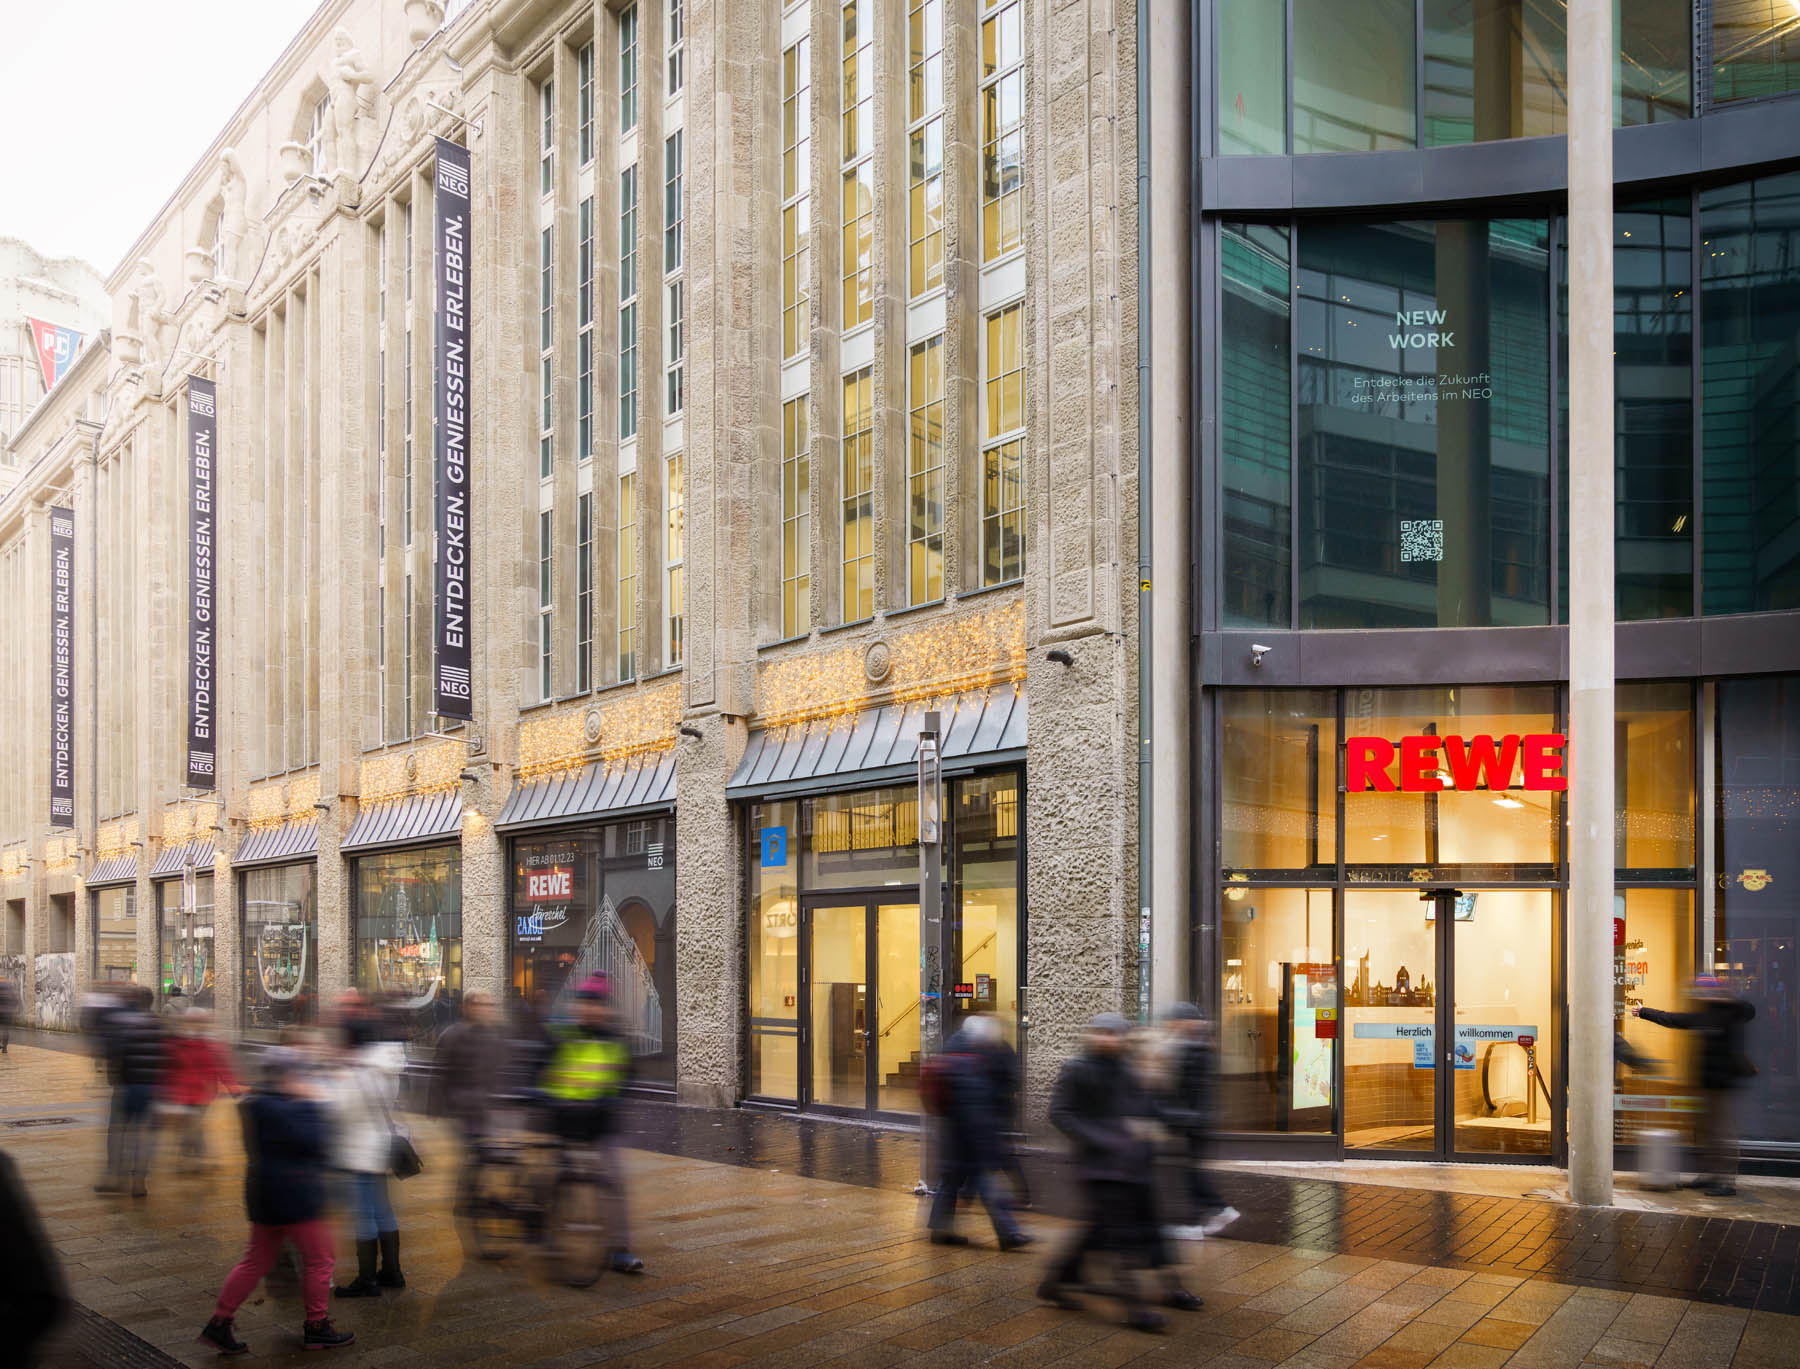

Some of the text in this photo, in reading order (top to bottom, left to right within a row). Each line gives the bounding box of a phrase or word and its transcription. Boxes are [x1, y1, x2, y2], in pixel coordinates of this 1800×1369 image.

[439, 173, 468, 194] NEO
[1396, 310, 1447, 326] NEW
[1388, 332, 1455, 349] WORK
[1354, 373, 1490, 388] Entdecke die Zukunft
[1351, 388, 1493, 403] des Arbeitens im NEO
[191, 402, 214, 414] NEO
[446, 215, 464, 648] ENTDECKEN. GENIESSEN. ERLEBEN.
[53, 525, 73, 536] NEO
[195, 429, 210, 739] ENTDECKEN. GENIESSEN. ERLEBEN.
[56, 547, 69, 788] ENTDECKEN. GENIESSEN. ERLEBEN.
[441, 680, 469, 695] NEO
[190, 762, 214, 772] NEO
[1347, 734, 1567, 792] REWE
[53, 806, 72, 814] NEO
[526, 855, 540, 866] HIER
[541, 854, 549, 865] AB
[648, 856, 663, 866] NEO
[529, 873, 570, 896] REWE
[1396, 1027, 1514, 1039] Herzlich willkommen
